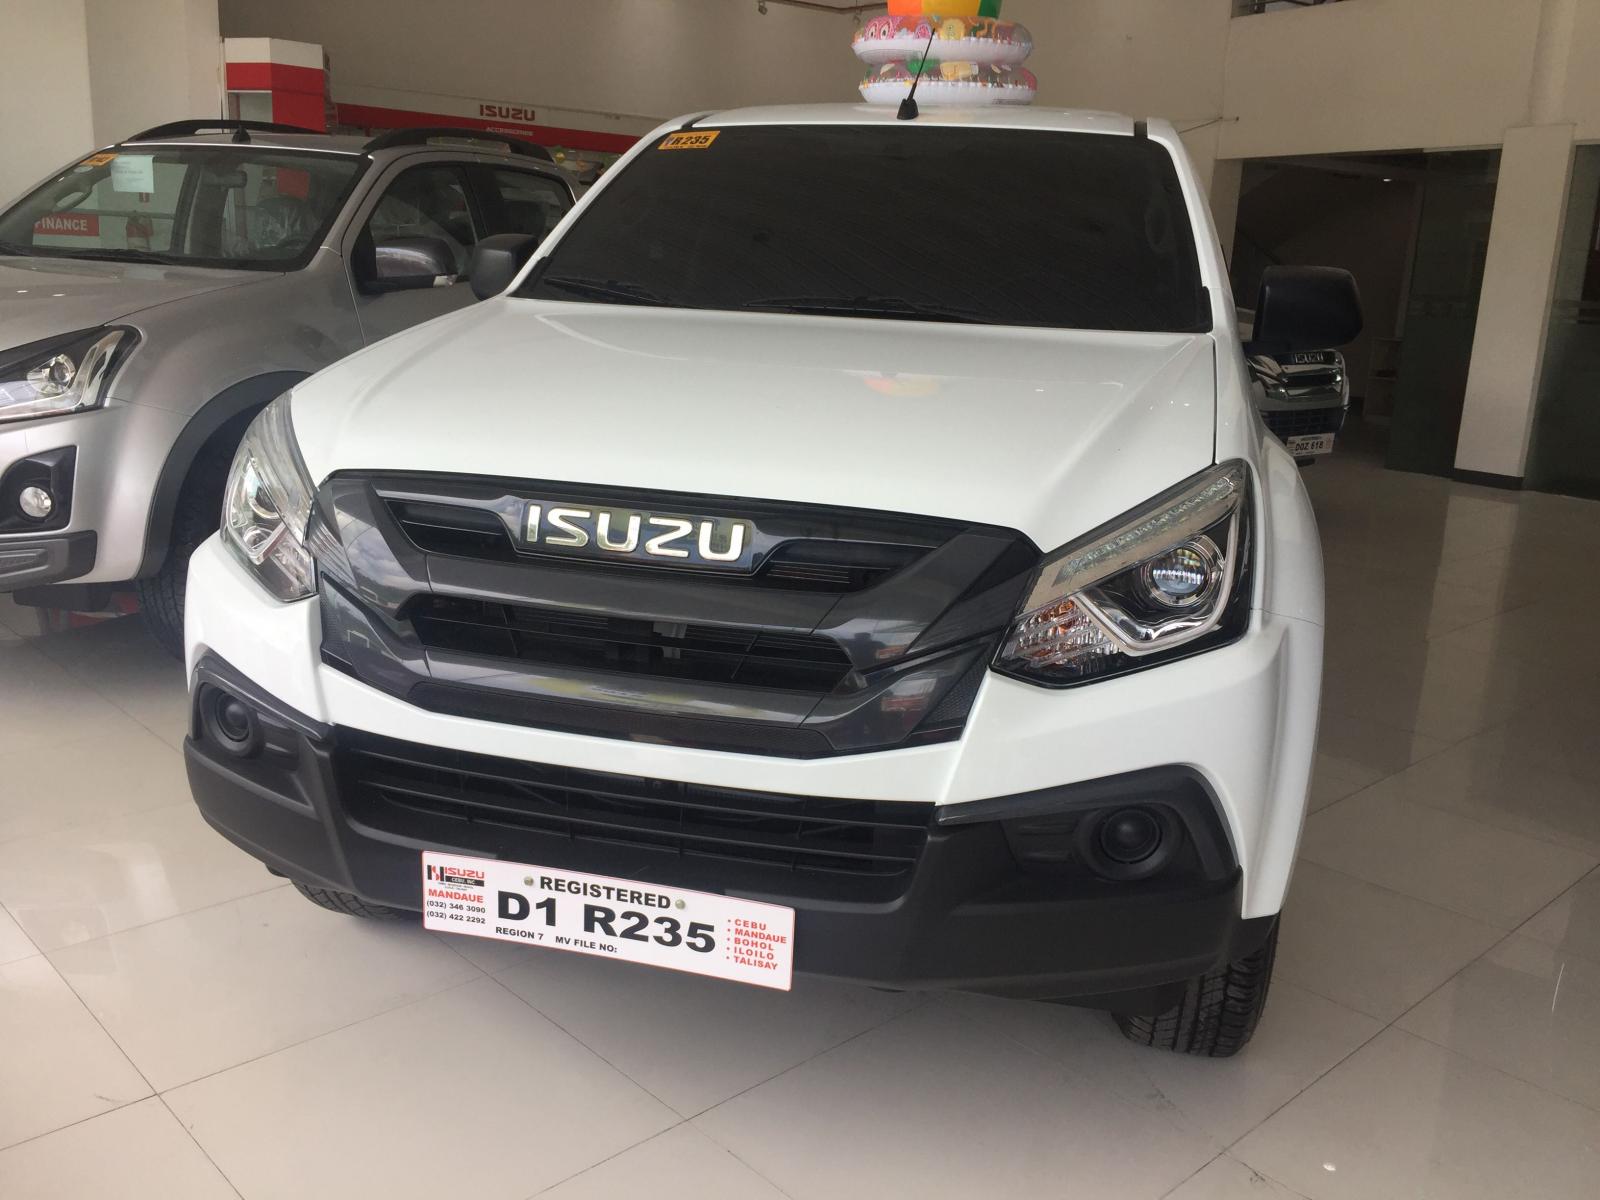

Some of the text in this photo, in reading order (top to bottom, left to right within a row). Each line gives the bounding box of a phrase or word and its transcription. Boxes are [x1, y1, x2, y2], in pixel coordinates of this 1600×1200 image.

[480, 105, 535, 121] ISUZU
[526, 504, 745, 562] ISUZU
[444, 867, 485, 879] ISUZU
[428, 888, 484, 903] MANDAUE
[540, 876, 671, 909] REGISTERED
[426, 900, 486, 914] (032) 346 3090
[426, 910, 486, 925] (032) 422 2292
[498, 890, 716, 953] D1 R235
[734, 918, 766, 931] CEBU
[495, 926, 544, 941] REGION 7
[734, 928, 787, 944] MANDAUE
[555, 936, 617, 953] MV FILE NO:
[734, 938, 774, 951] BOHOL
[734, 947, 774, 960] ILOILO
[734, 956, 778, 971] TALISAY
